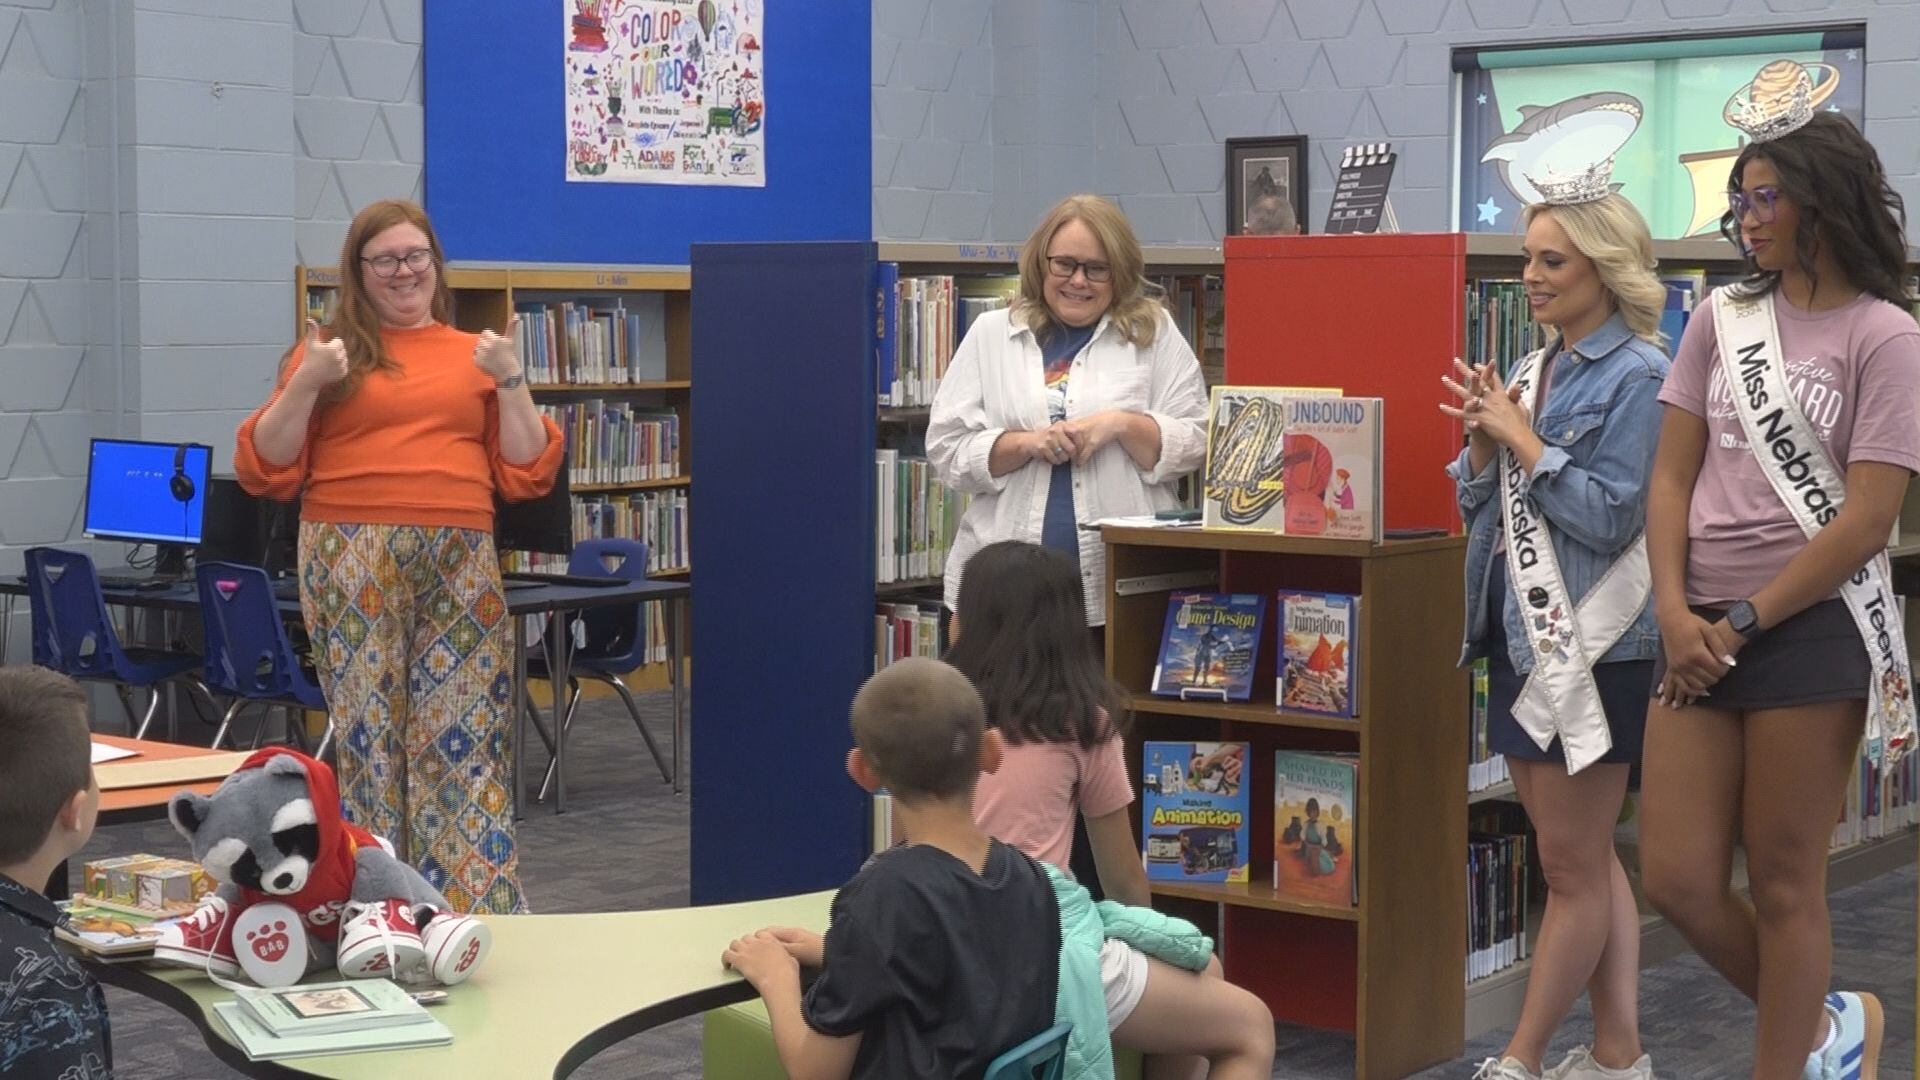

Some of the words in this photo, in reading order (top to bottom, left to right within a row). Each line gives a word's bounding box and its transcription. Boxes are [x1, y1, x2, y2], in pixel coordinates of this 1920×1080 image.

[631, 7, 682, 48] COLOR
[631, 59, 684, 100] WORLD
[638, 150, 675, 162] ADAMS
[1737, 340, 1771, 411] Miss
[1757, 407, 1838, 528] Nebras
[1507, 448, 1539, 571] ebraska
[1213, 608, 1256, 630] Design
[1293, 614, 1346, 637] nimation
[1152, 805, 1242, 826] Animation
